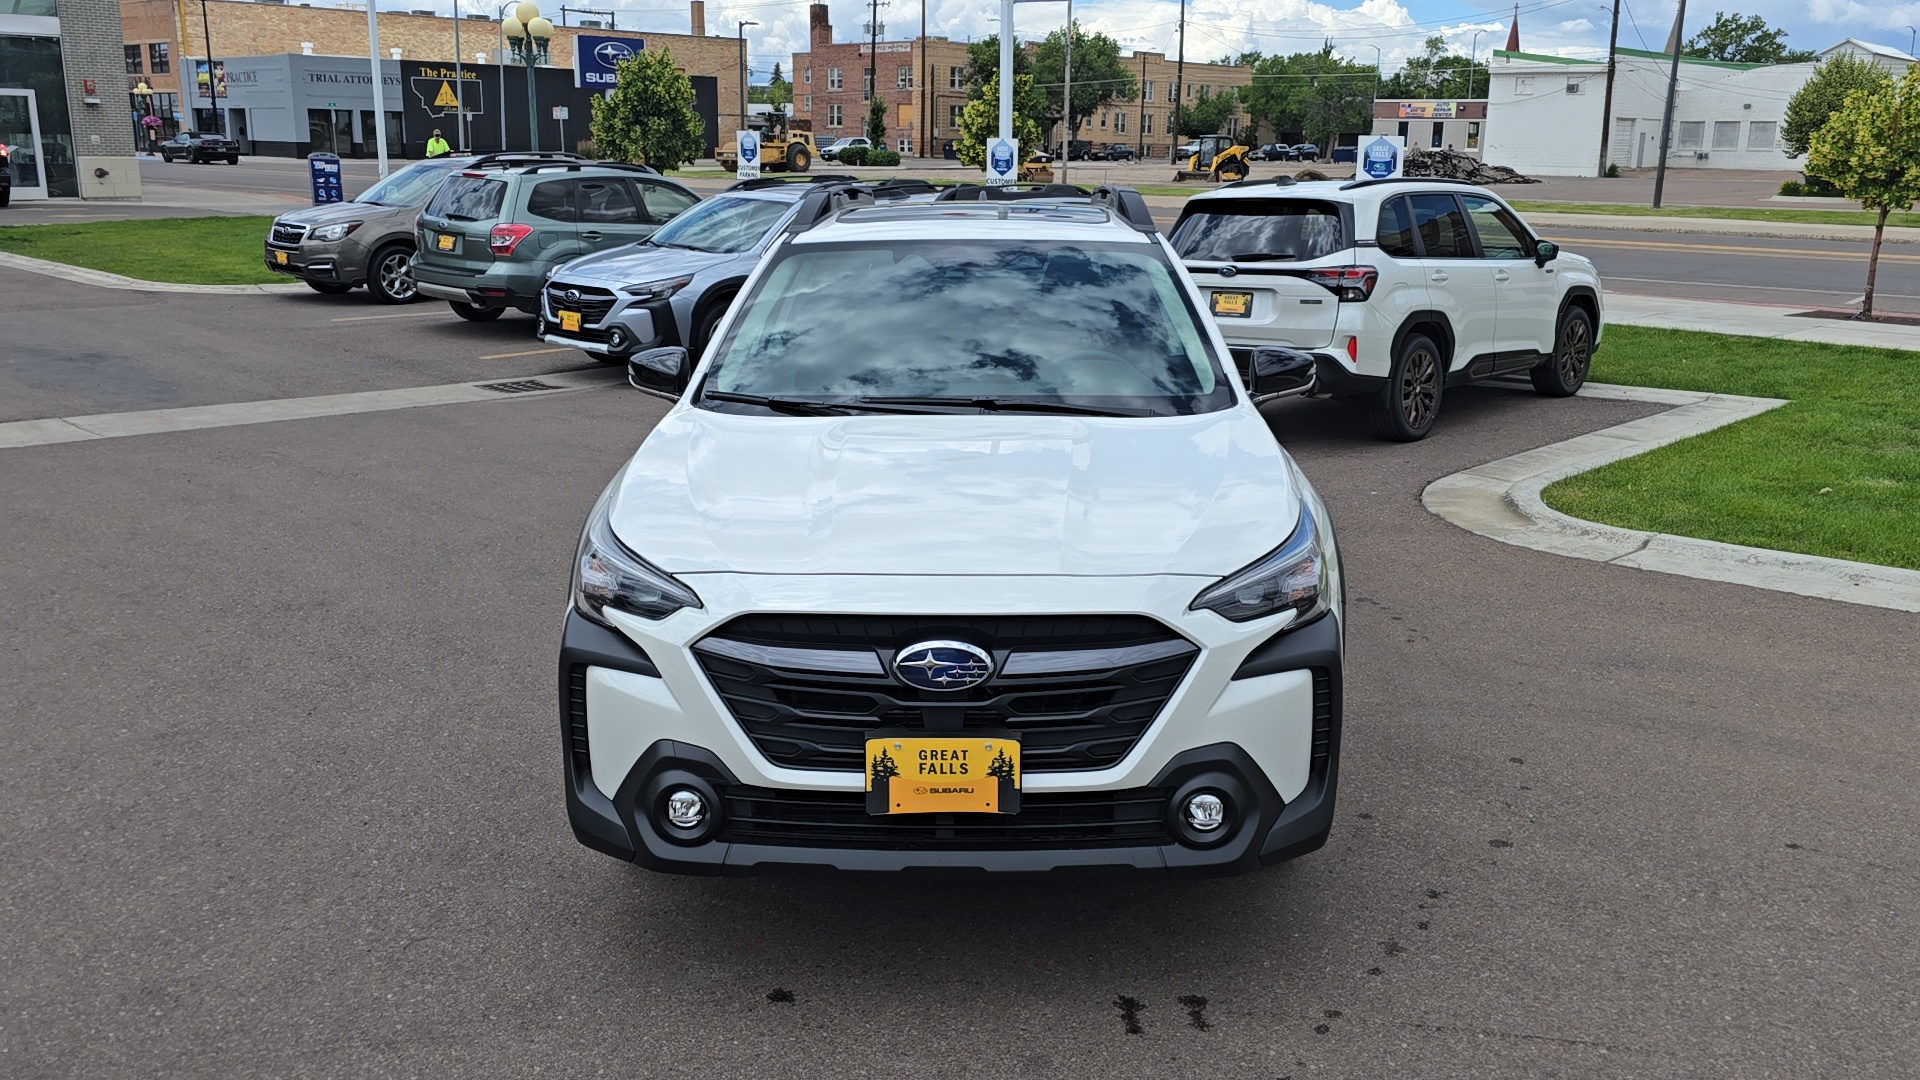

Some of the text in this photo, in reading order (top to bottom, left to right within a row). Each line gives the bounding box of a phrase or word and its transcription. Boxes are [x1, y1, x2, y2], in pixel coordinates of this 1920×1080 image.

[226, 71, 258, 83] PRACTICE
[308, 73, 401, 86] TRIAL ATTOEYS
[419, 67, 477, 80] The Pratice
[585, 72, 618, 83] SUB
[918, 749, 969, 761] GREAT
[918, 762, 969, 775] FALLS
